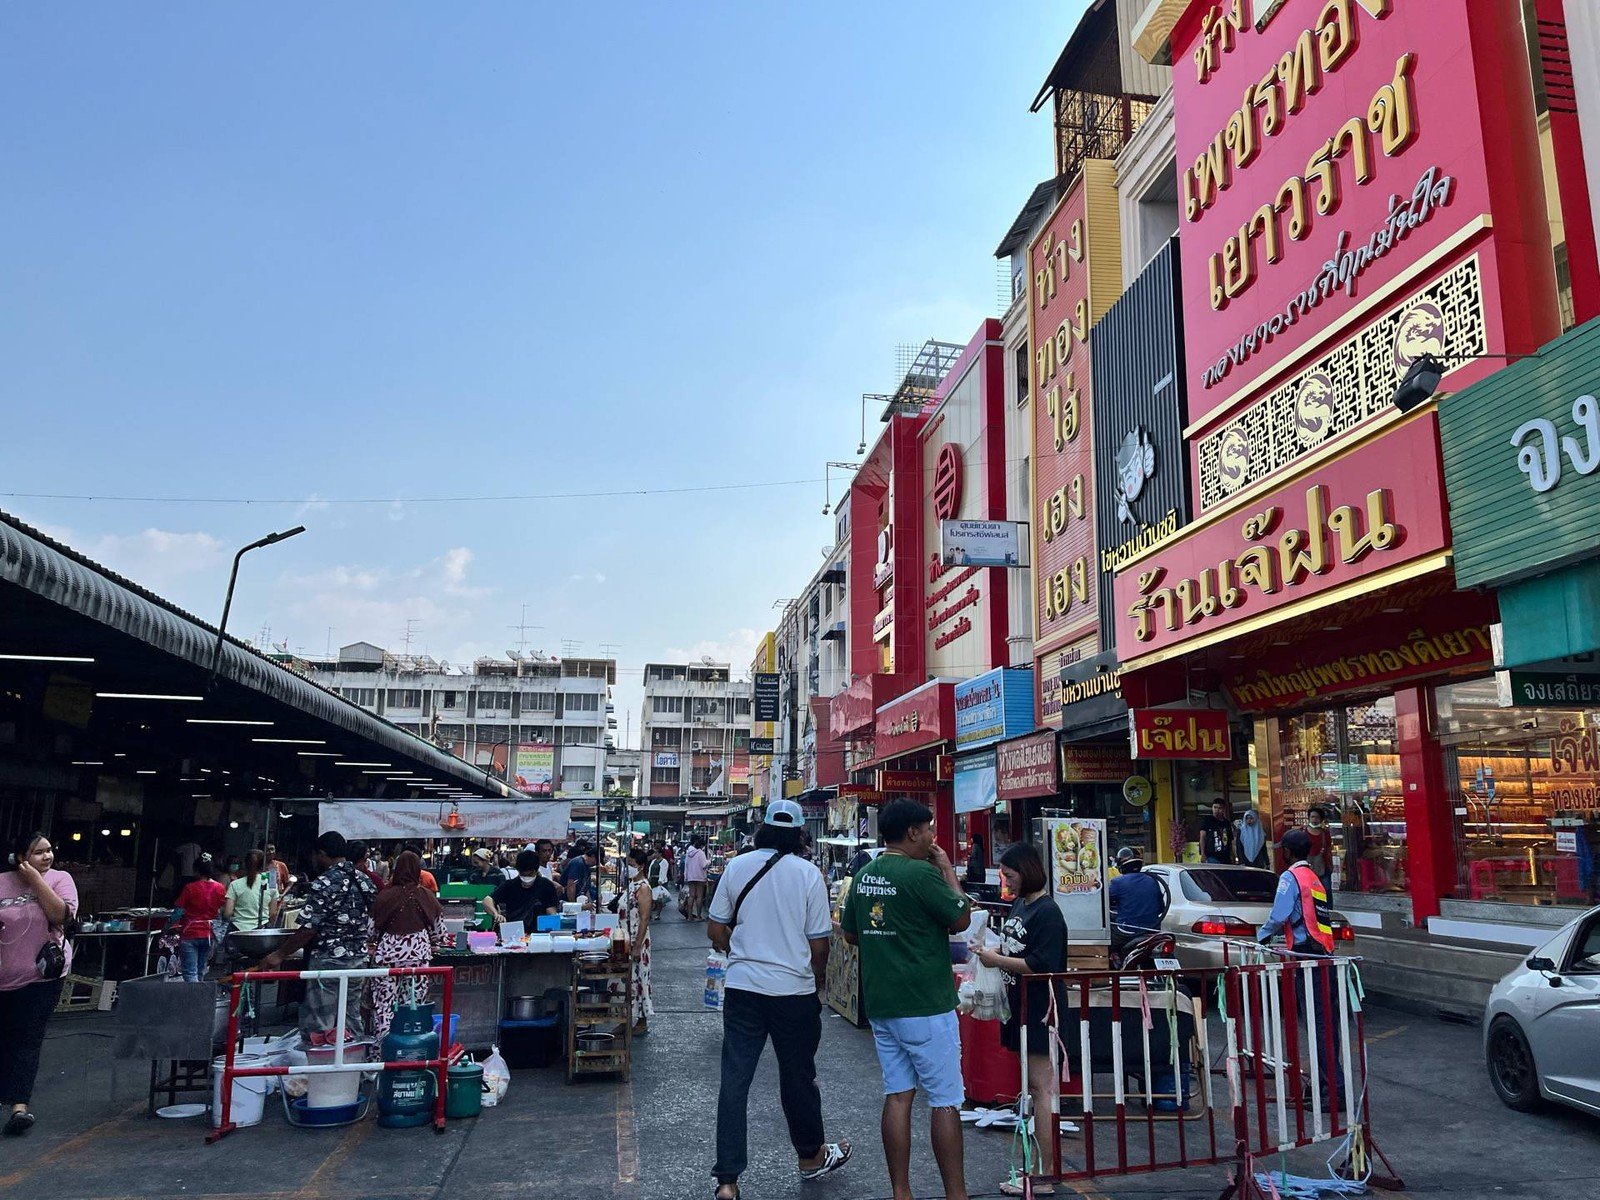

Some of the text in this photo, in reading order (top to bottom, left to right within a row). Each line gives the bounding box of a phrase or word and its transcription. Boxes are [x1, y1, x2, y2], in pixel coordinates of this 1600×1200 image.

[1194, 0, 1248, 84] ห้าง
[1184, 0, 1389, 222] เพชรทอ
[1208, 53, 1413, 311] เยาวราช
[1036, 218, 1084, 310] ห้าง
[1036, 298, 1088, 389] ทอง
[1510, 394, 1600, 493] จง
[1042, 473, 1086, 543] เฮง
[1044, 556, 1088, 621] เฮง
[1128, 484, 1400, 643] ร้านเจ๊ฝน
[1232, 624, 1490, 704] ห้างใหญ่เพชรทองดีเยา
[1141, 716, 1225, 753] เจ๊ฝน
